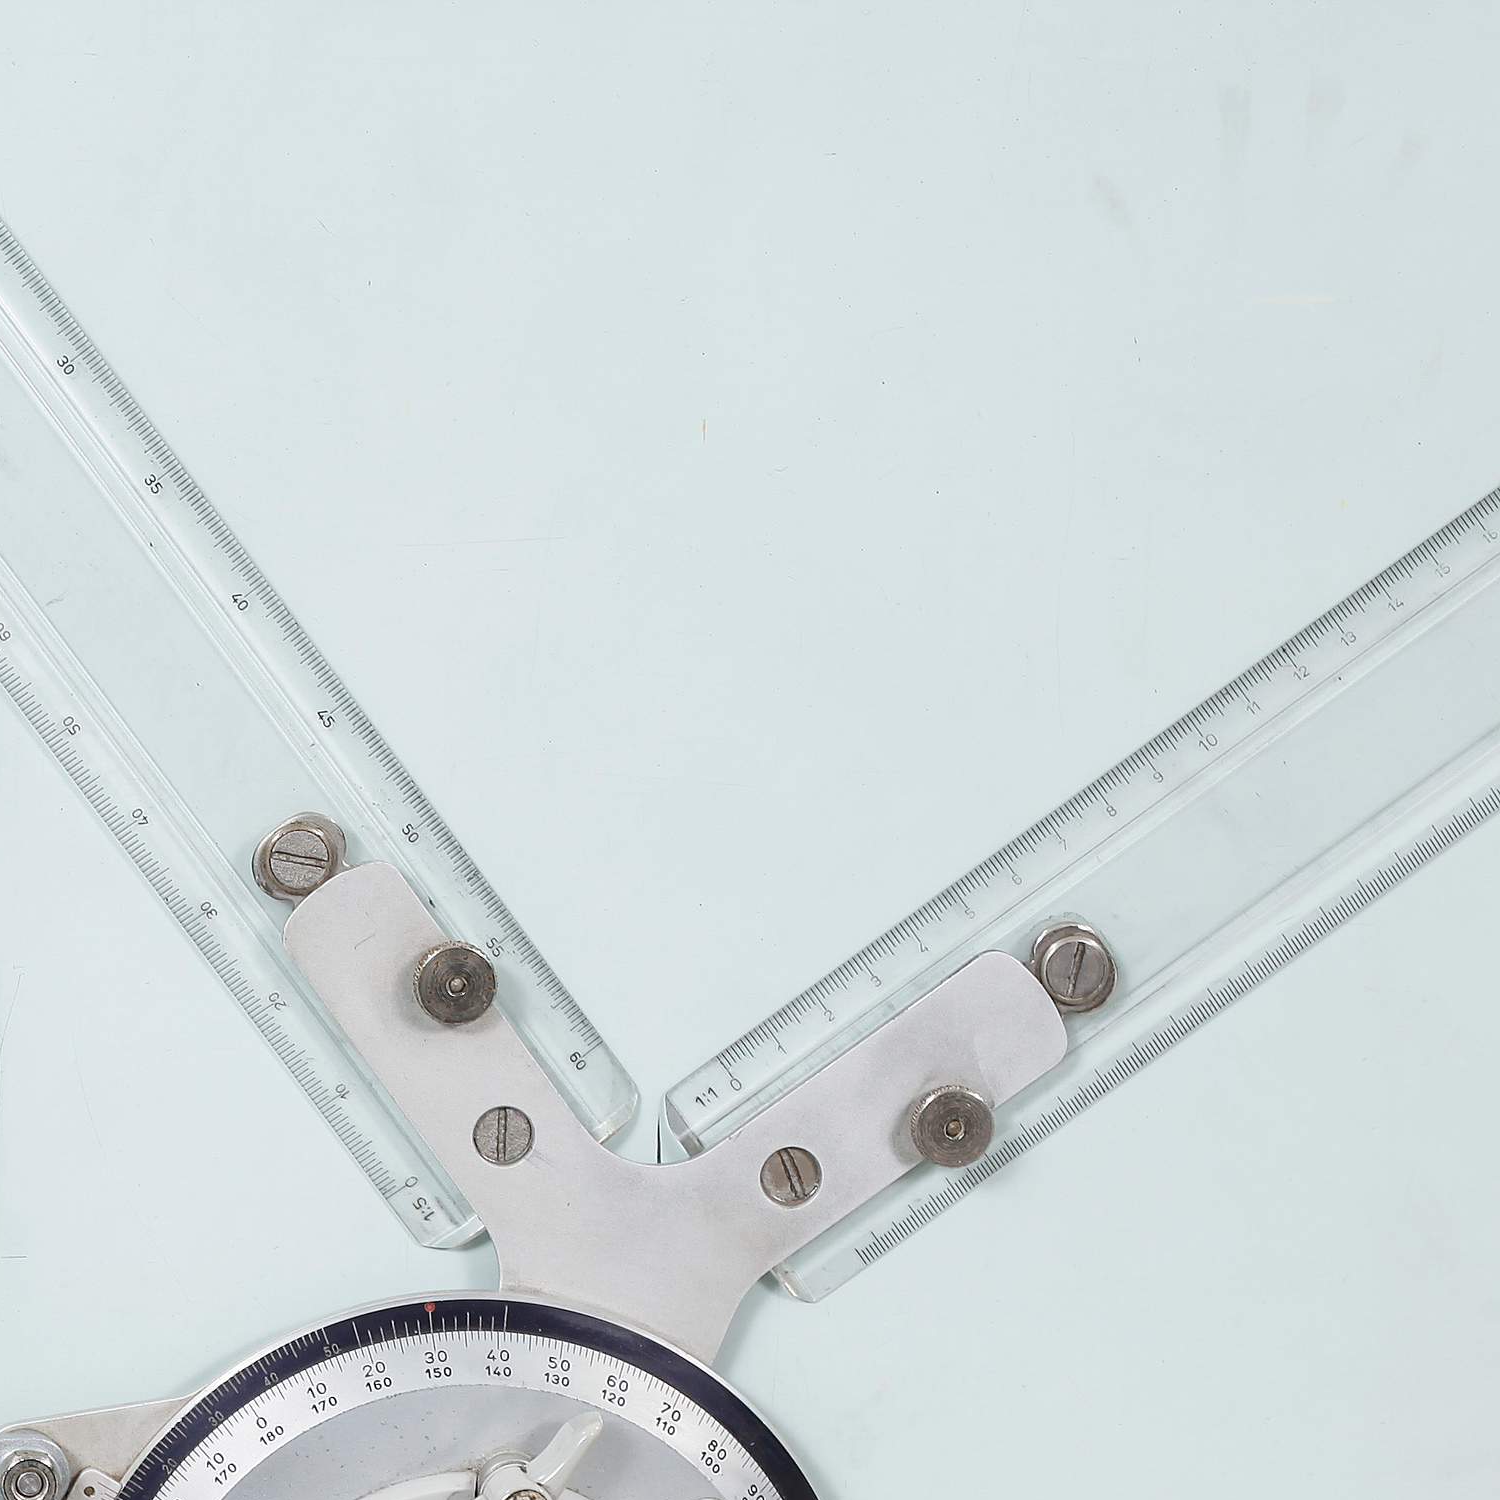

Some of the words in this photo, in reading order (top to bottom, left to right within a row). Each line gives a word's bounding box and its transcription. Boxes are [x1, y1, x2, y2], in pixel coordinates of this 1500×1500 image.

[57, 355, 75, 376] 30
[144, 473, 162, 495] 35
[1483, 529, 1499, 544] 16
[1434, 562, 1452, 578] 15
[231, 591, 249, 612] 40
[1388, 598, 1405, 612] 14
[1340, 630, 1358, 647] 13
[1293, 665, 1311, 681] 12
[1247, 701, 1262, 716] 11
[62, 716, 81, 736] 50
[317, 709, 335, 728] 45
[1198, 733, 1219, 752] 10
[1153, 771, 1164, 784] 9
[131, 808, 149, 828] 40
[1106, 805, 1118, 817] 8
[402, 823, 420, 845] 50
[1057, 839, 1068, 851] 7
[1012, 873, 1022, 886] 6
[200, 900, 219, 920] 30
[965, 907, 976, 919] 5
[919, 941, 929, 953] 4
[870, 975, 882, 987] 3
[268, 991, 288, 1011] 20
[824, 1009, 836, 1022] 2
[776, 1042, 787, 1054] 1
[569, 1051, 587, 1071] 60
[336, 1083, 351, 1102] 10
[730, 1078, 742, 1092] 0
[695, 1086, 720, 1109] 1:1
[405, 1175, 418, 1189] 0
[411, 1196, 435, 1224] 1:5
[324, 1343, 339, 1357] 50
[425, 1350, 448, 1364] 30
[487, 1350, 509, 1362] 40
[363, 1361, 386, 1378] 20
[425, 1367, 452, 1378] 150
[485, 1366, 512, 1377] 140
[548, 1357, 571, 1372] 50
[264, 1372, 279, 1386] 40
[365, 1377, 393, 1393] 160
[545, 1372, 570, 1387] 130
[607, 1375, 629, 1392] 60
[306, 1383, 327, 1399] 10
[602, 1390, 626, 1407] 120
[311, 1396, 338, 1414] 170
[660, 1402, 681, 1422] 70
[209, 1411, 224, 1426] 30
[256, 1417, 267, 1429] 0
[655, 1417, 675, 1435] 110
[259, 1425, 284, 1446] 180
[708, 1440, 727, 1460] 80
[162, 1458, 177, 1474] 20
[206, 1452, 224, 1471] 10
[700, 1451, 720, 1474] 100
[214, 1463, 237, 1485] 170
